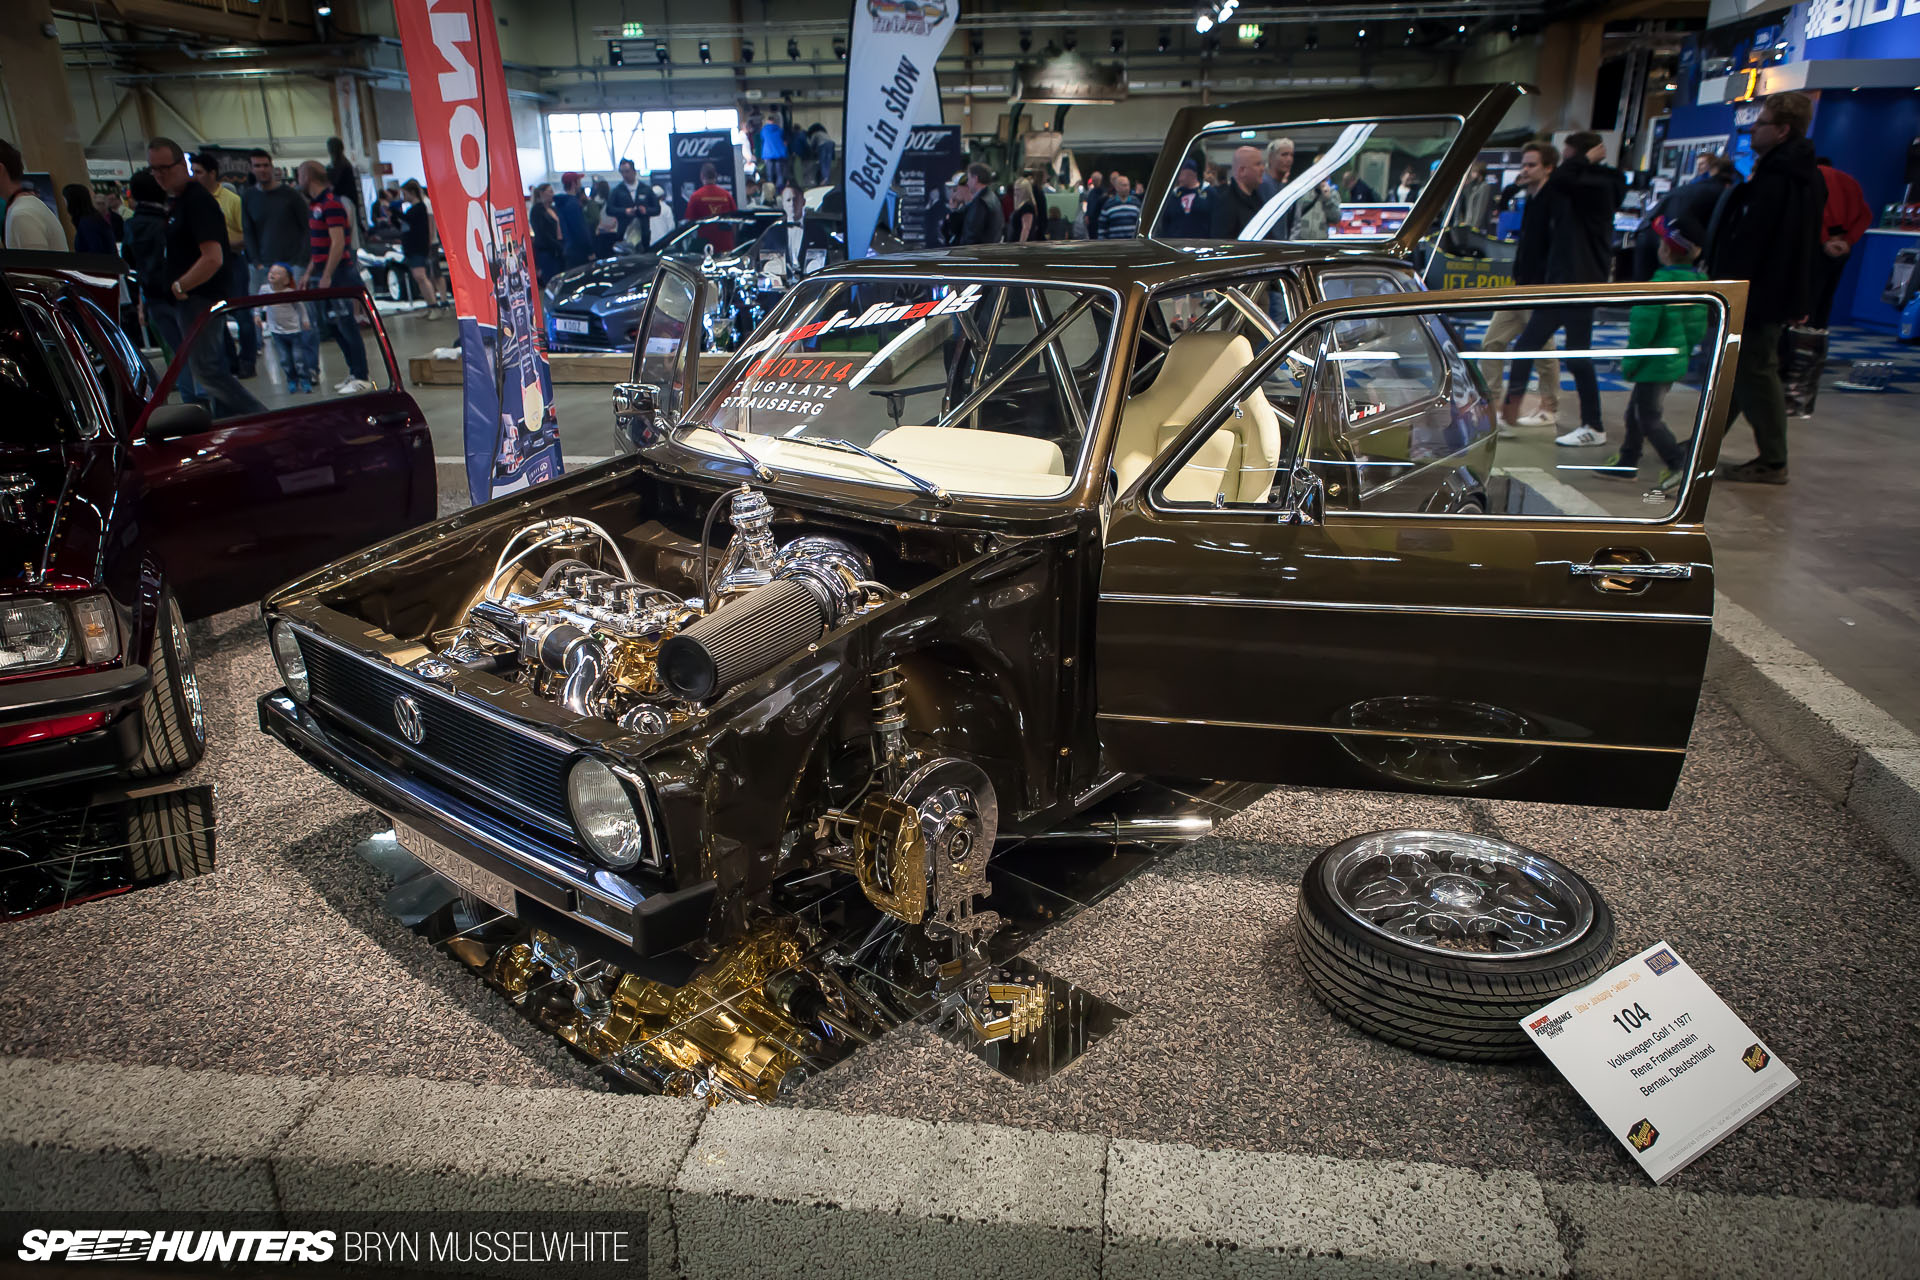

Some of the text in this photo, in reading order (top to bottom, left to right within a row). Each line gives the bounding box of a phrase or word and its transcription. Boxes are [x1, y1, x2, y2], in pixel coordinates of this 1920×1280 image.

[881, 54, 920, 120] show
[867, 119, 899, 151] in
[849, 142, 888, 200] Best
[745, 358, 854, 382] 05/07/14
[720, 396, 825, 416] STRAUSBERG
[731, 381, 838, 399] FLUGPLATZ
[1534, 1011, 1573, 1036] PERFORMANCE
[1547, 1024, 1564, 1039] SHOW
[1612, 1002, 1652, 1034] 104
[1607, 1038, 1654, 1069] Volkswagen
[1652, 1025, 1669, 1041] Golf
[1673, 1012, 1692, 1028] 1977
[1630, 1032, 1698, 1078] Rene Frankenstein
[1640, 1043, 1715, 1097] Bernau, Deutschland
